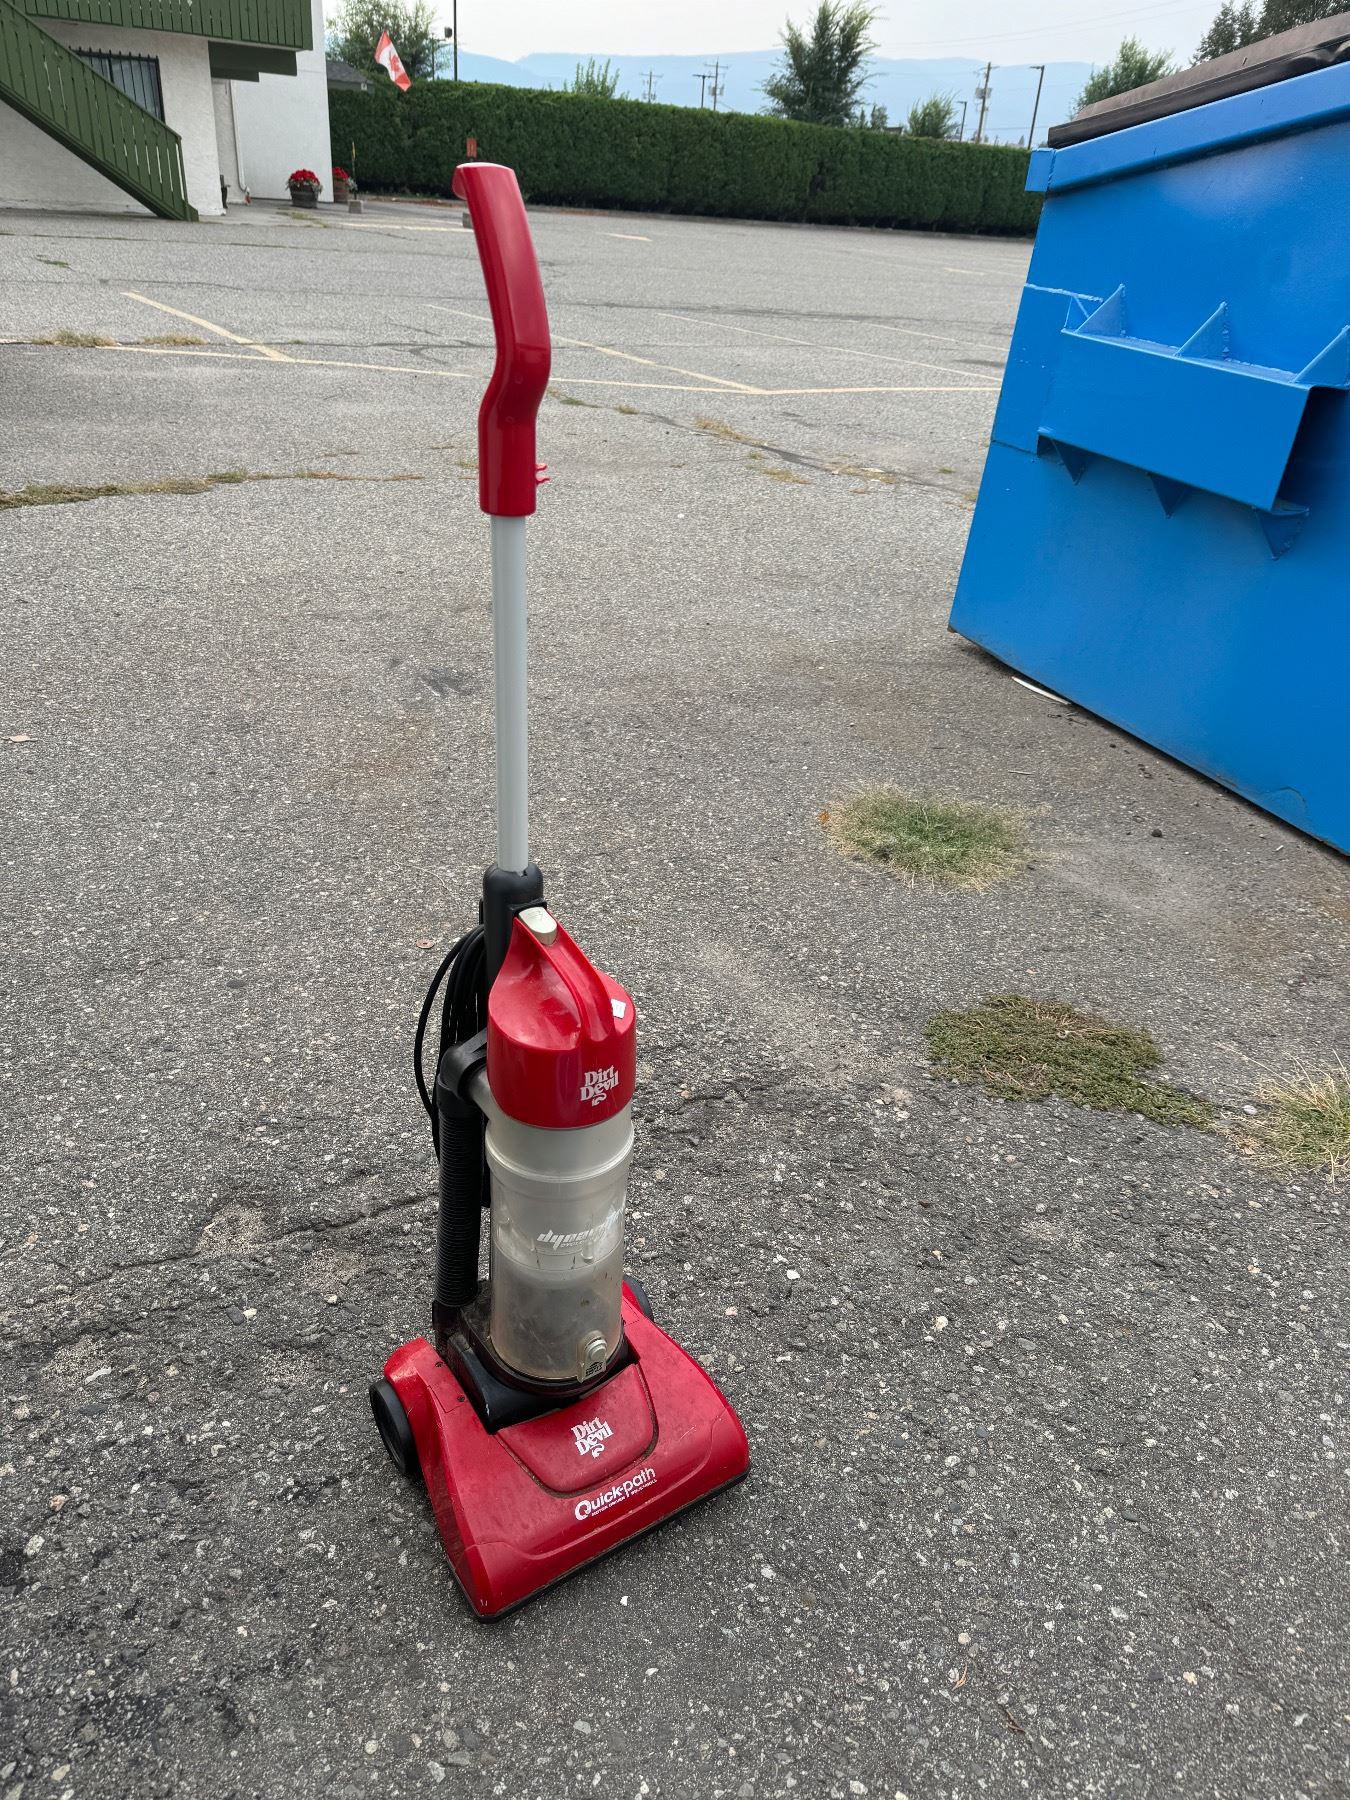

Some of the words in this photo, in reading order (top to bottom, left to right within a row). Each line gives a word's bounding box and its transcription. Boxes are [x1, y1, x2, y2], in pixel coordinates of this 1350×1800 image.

[580, 1070, 619, 1101] Devil
[584, 1065, 614, 1087] Dirt
[571, 1417, 603, 1441] Dirt
[575, 1421, 614, 1456] Devil
[574, 1467, 656, 1521] Quick-path
